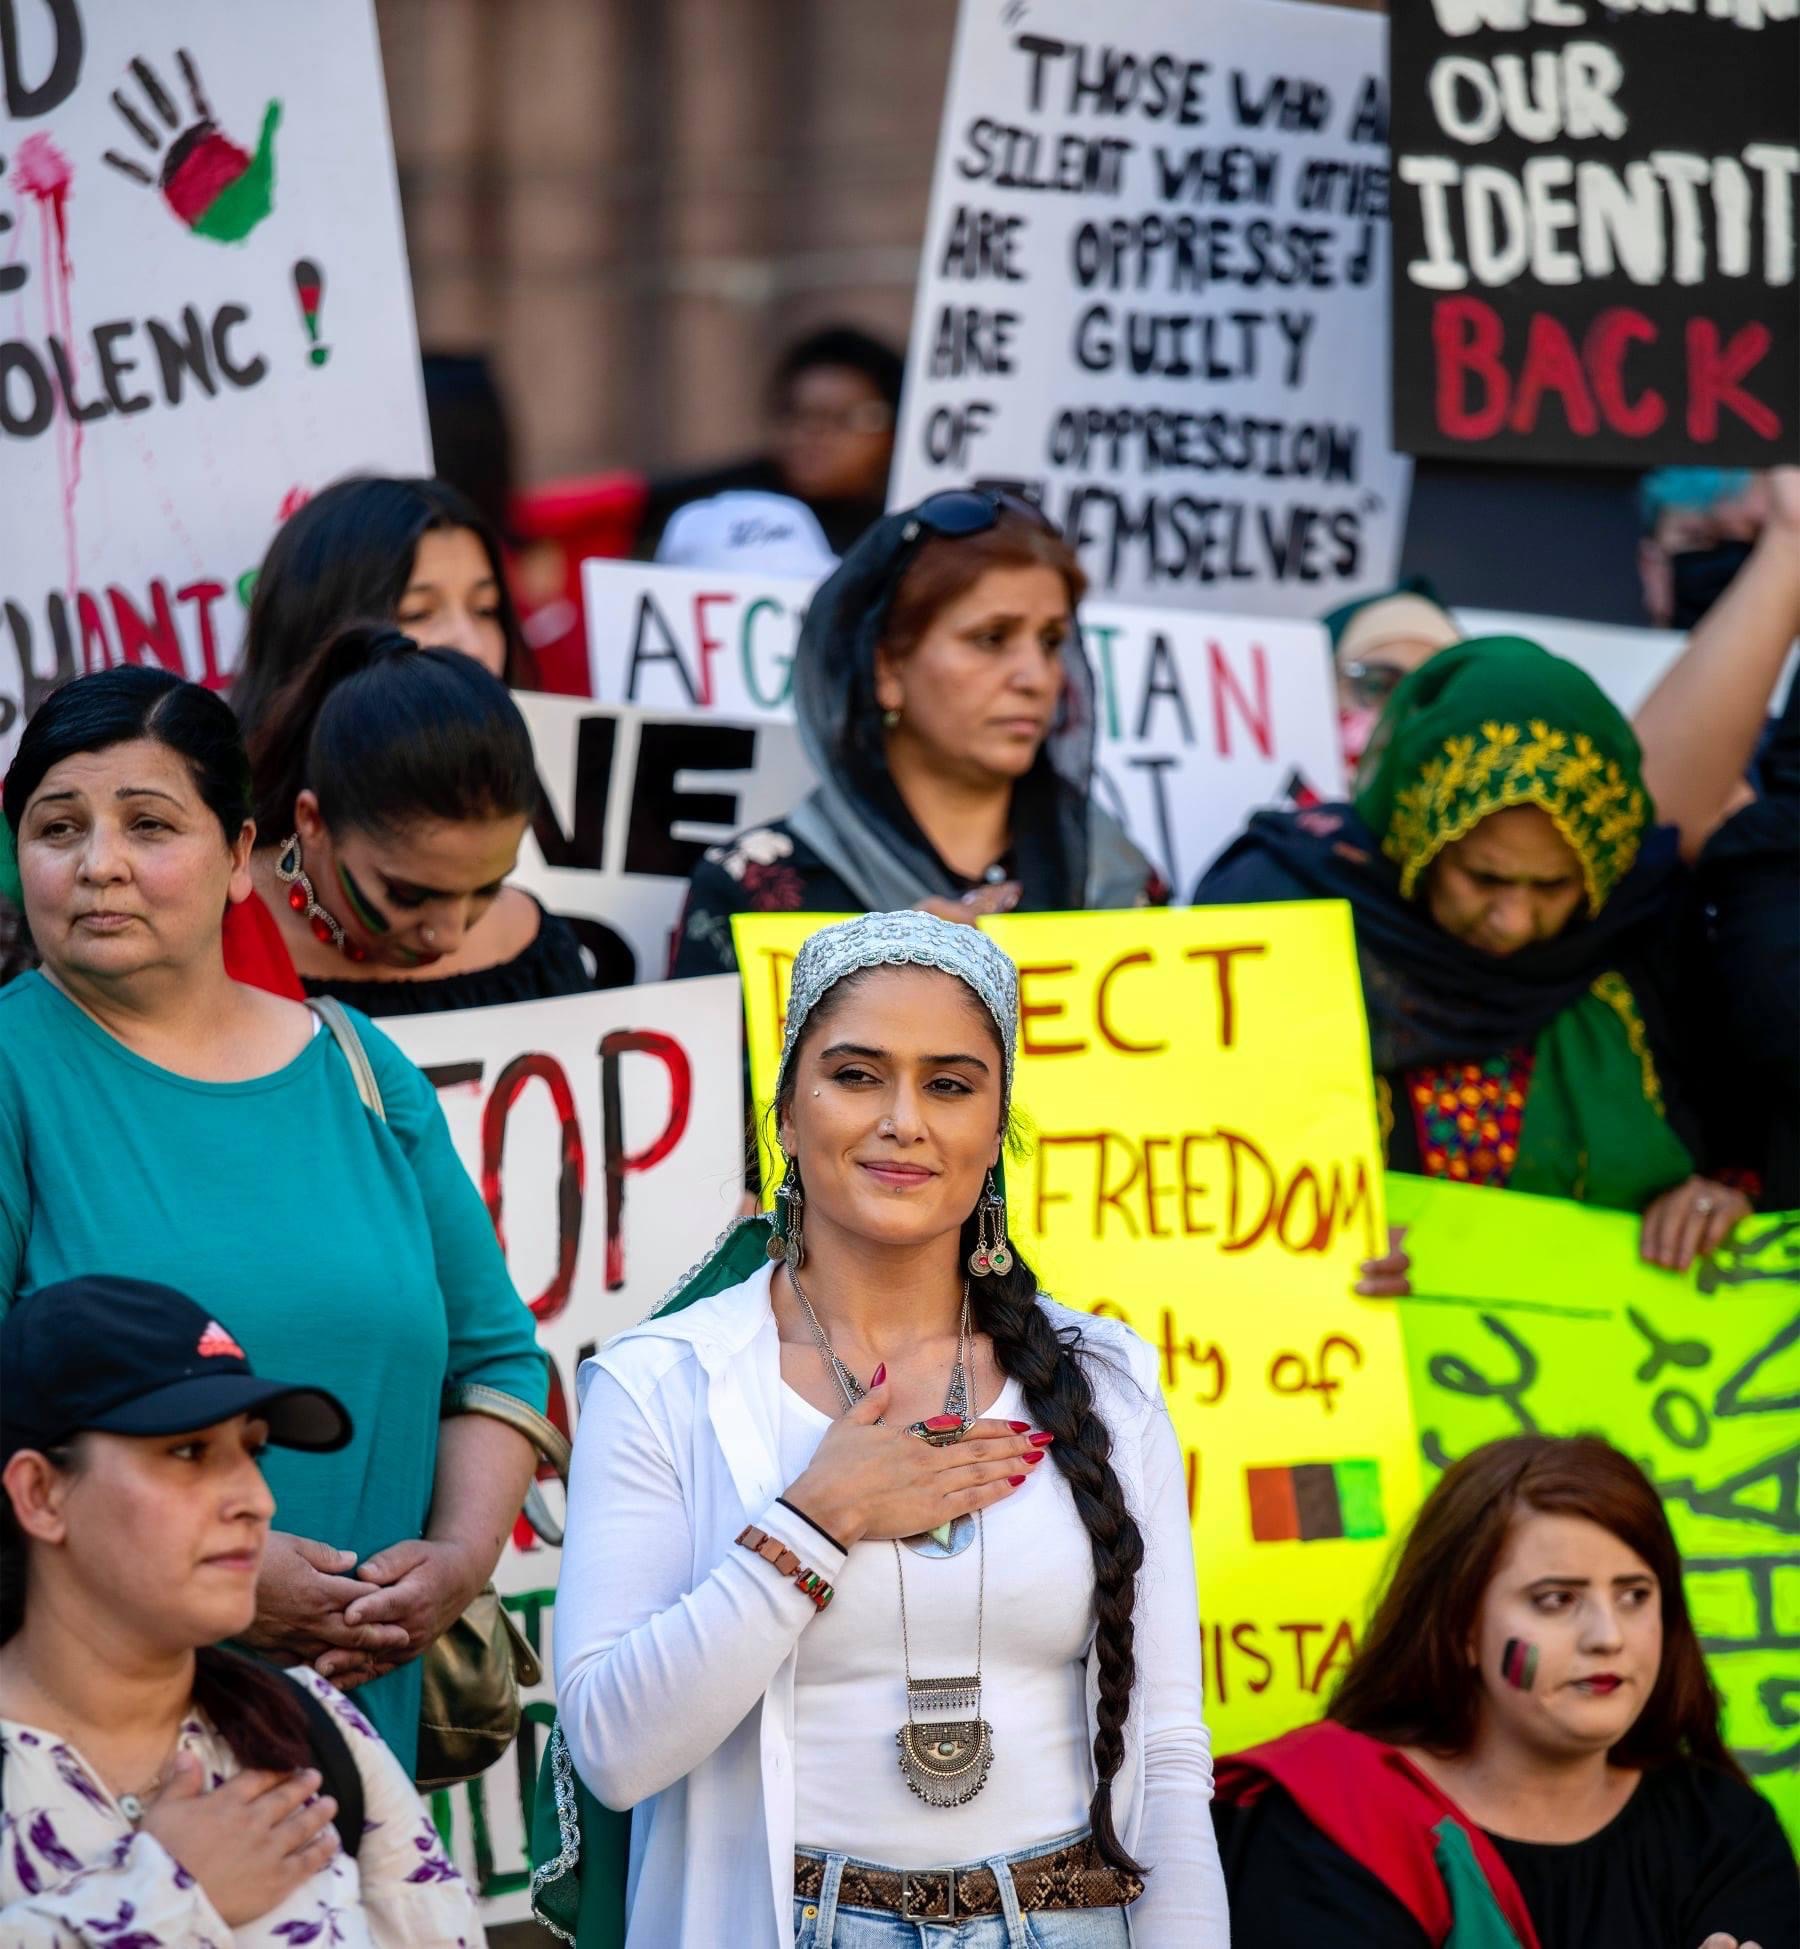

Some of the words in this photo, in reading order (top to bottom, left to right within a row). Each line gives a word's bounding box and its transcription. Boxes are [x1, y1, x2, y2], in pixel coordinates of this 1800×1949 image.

[1229, 70, 1331, 133] WHO
[1429, 40, 1628, 145] OUR
[957, 117, 1134, 193] SILENT
[1154, 146, 1280, 207] WHEN
[941, 205, 1027, 281] ARE
[929, 306, 1023, 379] ARE
[1073, 306, 1313, 388] GUILTY
[1431, 295, 1783, 443] BACK
[922, 402, 995, 469] OF
[1047, 405, 1363, 484] OPPRESSION
[1035, 1128, 1374, 1262] FREEDOM
[1270, 1334, 1363, 1412] of
